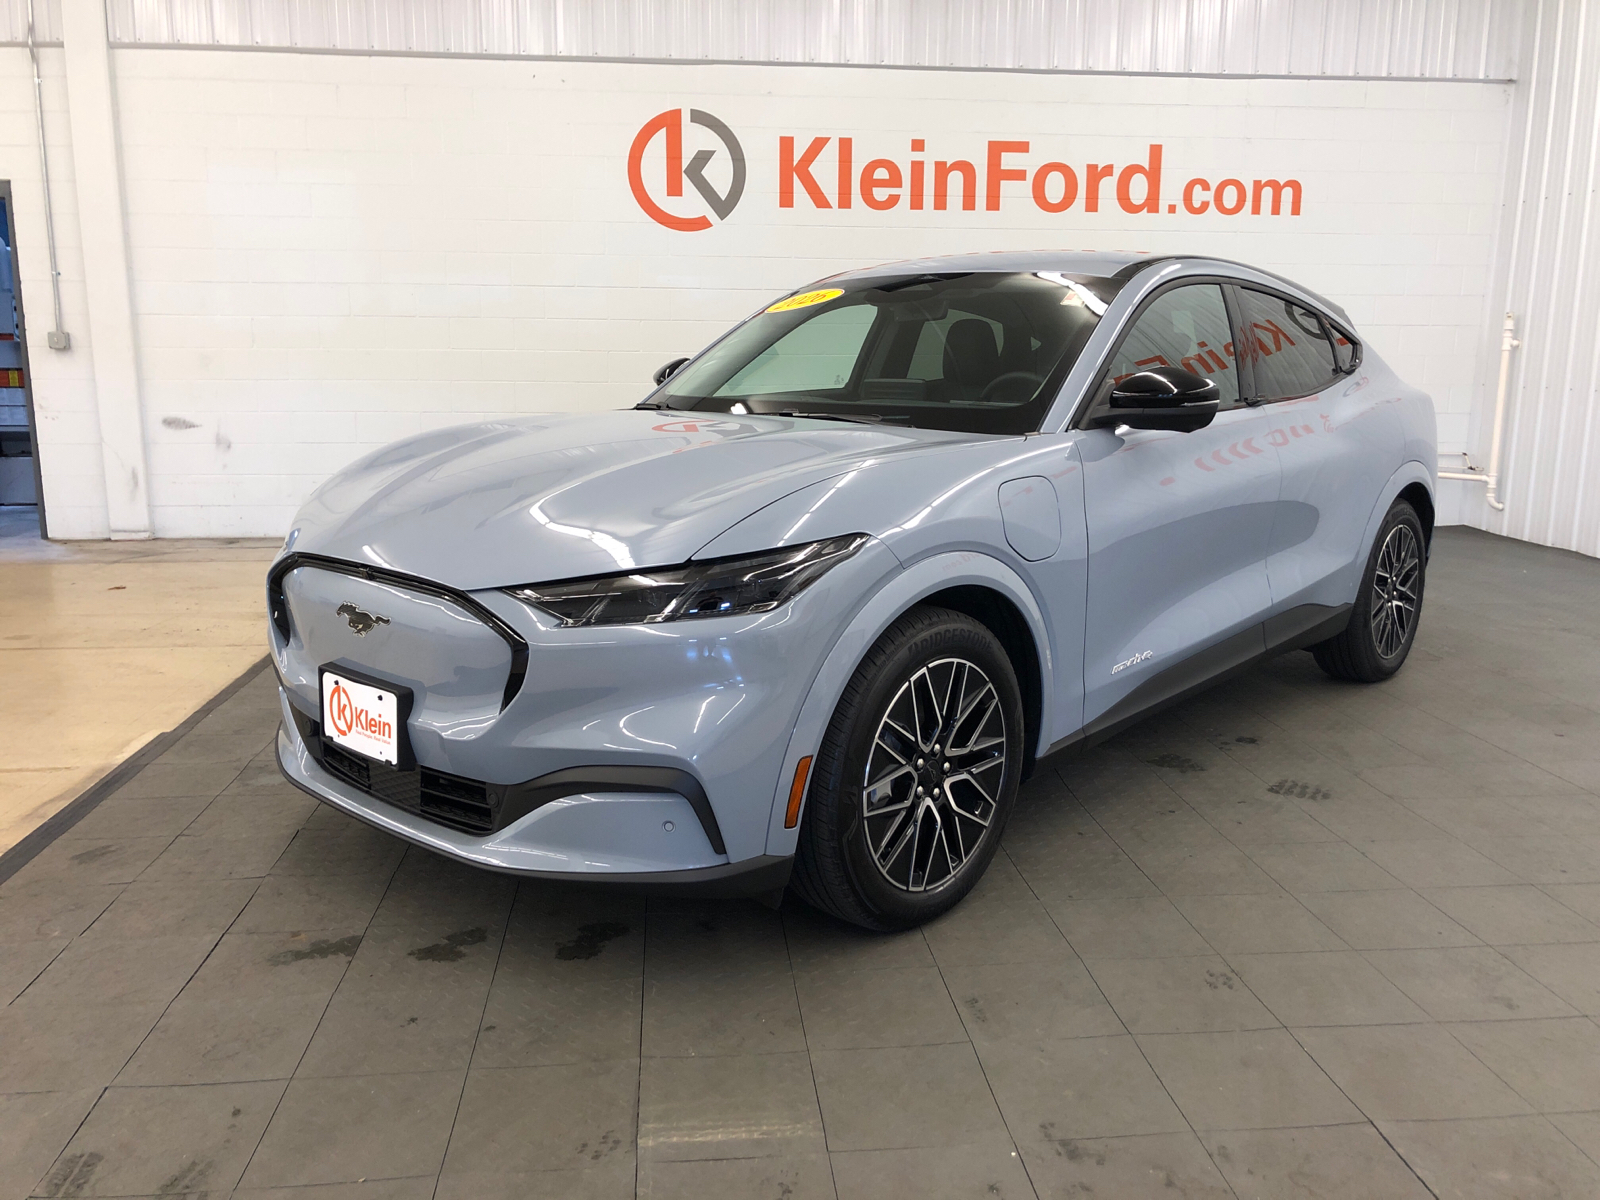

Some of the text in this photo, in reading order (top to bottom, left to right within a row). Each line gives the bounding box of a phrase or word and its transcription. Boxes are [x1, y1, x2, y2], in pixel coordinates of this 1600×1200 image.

[779, 136, 1302, 216] KleinFord.com
[907, 628, 994, 658] BRIDGESTONE
[355, 706, 391, 739] Klein
